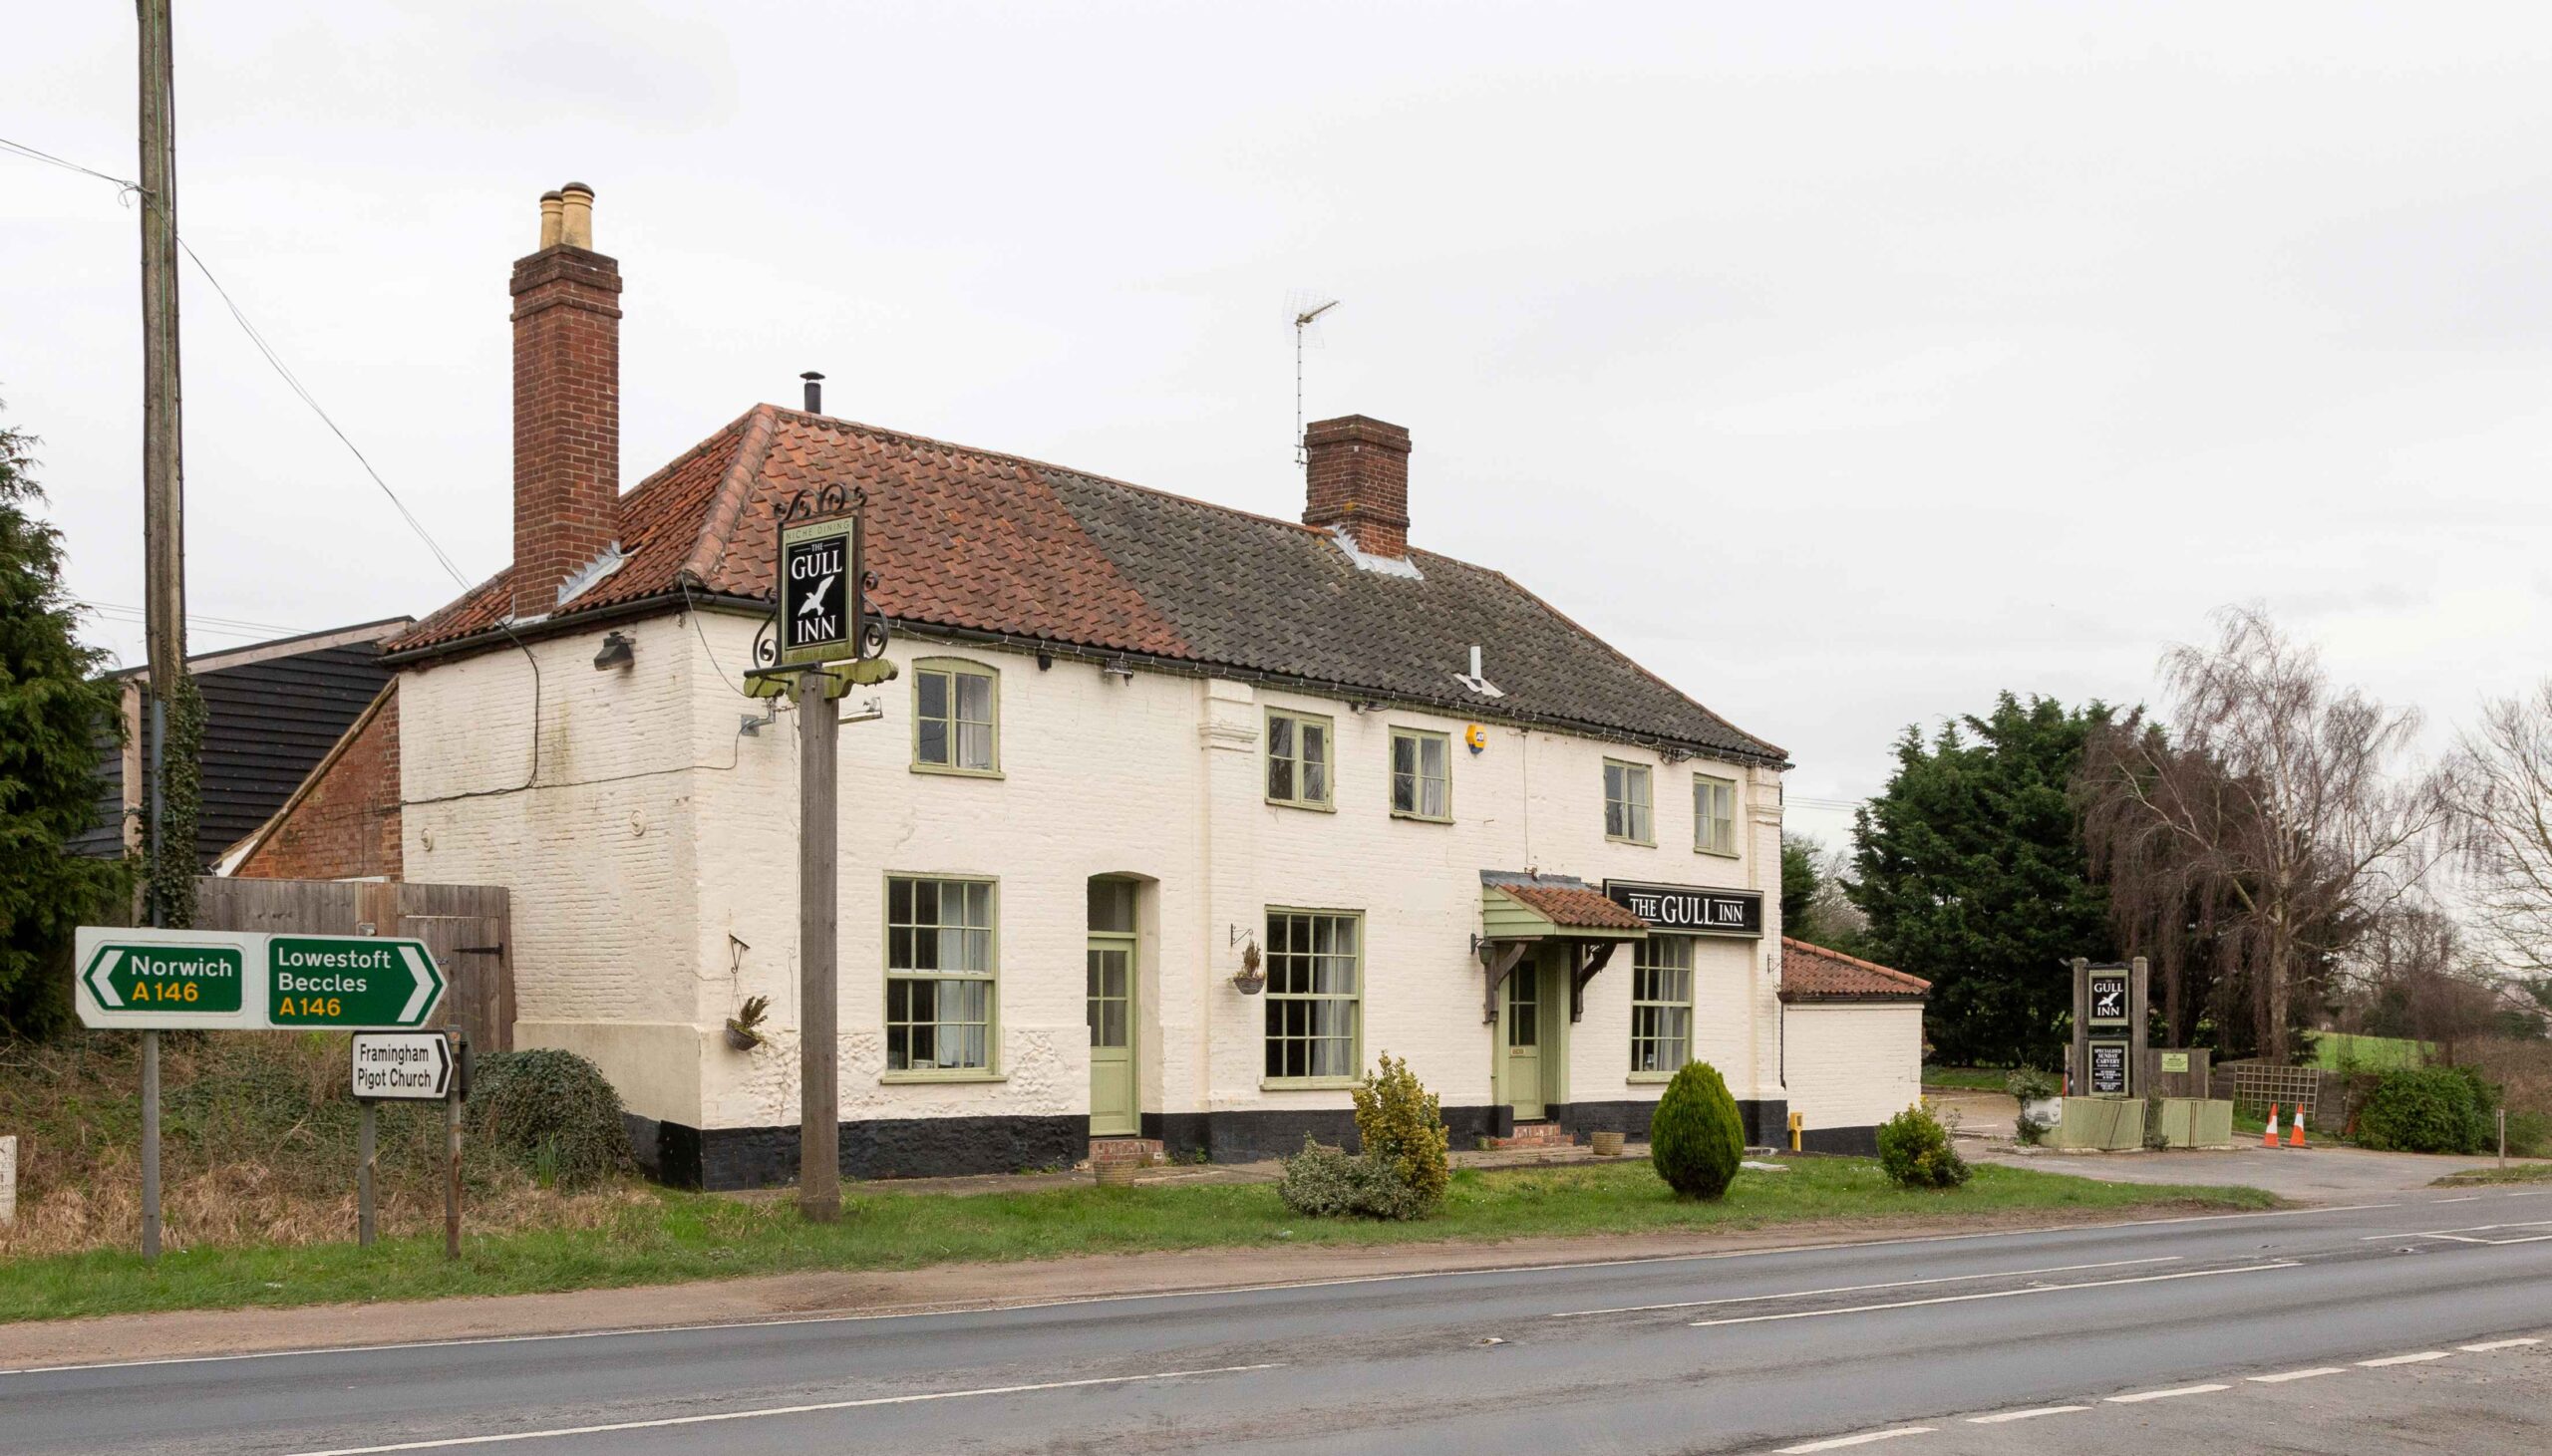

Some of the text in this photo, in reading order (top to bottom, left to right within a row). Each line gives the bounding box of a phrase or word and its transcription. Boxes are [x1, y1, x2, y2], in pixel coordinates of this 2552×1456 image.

[786, 520, 849, 540] NICHE DINING
[810, 542, 823, 552] THE
[792, 550, 842, 580] GULL
[797, 615, 836, 644] INN
[1629, 896, 1744, 925] THE GULL INN
[131, 956, 232, 978] Norwich
[277, 947, 392, 970] Lowestoft
[132, 982, 198, 1003] A146
[278, 973, 368, 994] Beccles
[2093, 983, 2123, 993] GULL
[279, 998, 341, 1018] A146
[2097, 1007, 2119, 1017] INN
[360, 1043, 430, 1066] Framingham
[357, 1068, 432, 1090] Pigot Church
